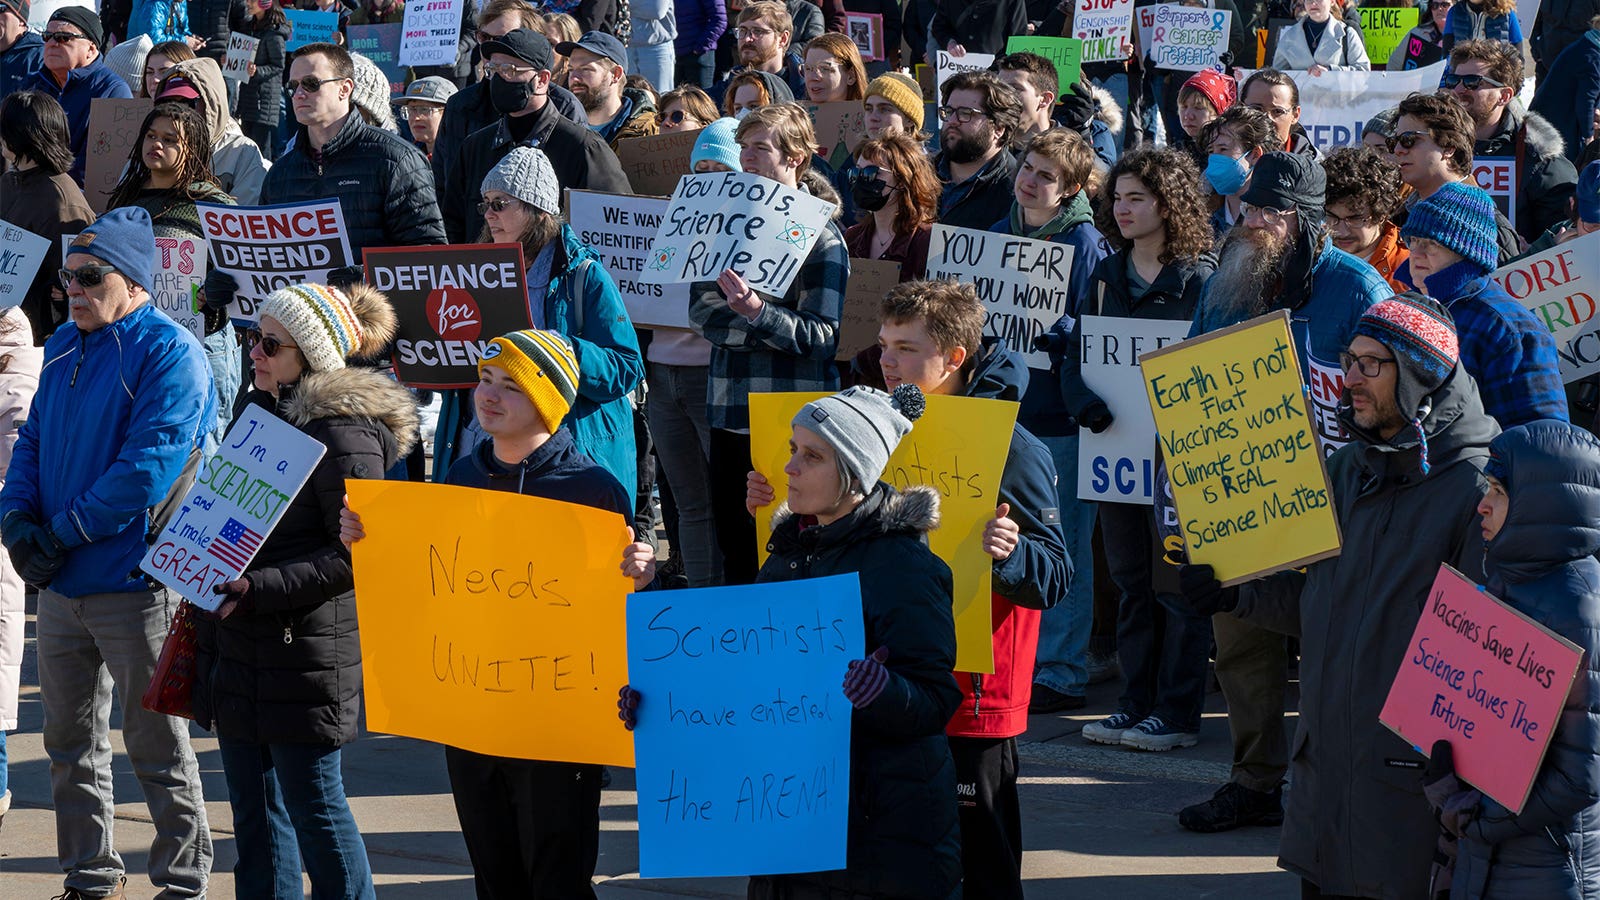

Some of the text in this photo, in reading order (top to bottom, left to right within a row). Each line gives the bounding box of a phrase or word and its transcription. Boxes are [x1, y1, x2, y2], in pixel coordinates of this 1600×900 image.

[408, 12, 456, 27] DISASTER
[426, 1, 452, 11] EVERY
[352, 38, 378, 49] MORE
[1091, 28, 1103, 38] IN
[204, 208, 339, 240] SCIENCE
[633, 212, 664, 229] WAN
[665, 206, 765, 241] Science
[220, 243, 331, 270] DEFEND
[942, 230, 1065, 282] YOU FEAR
[374, 262, 517, 291] DEFIANCE
[619, 279, 663, 298] FACTS
[151, 290, 189, 311] YOUR
[437, 290, 474, 335] for
[1013, 283, 1065, 314] WON'T
[396, 339, 488, 366] SCIEN
[1150, 337, 1289, 409] Earth is not
[1200, 386, 1247, 419] Flat
[1162, 393, 1304, 457] Vaccines work
[276, 459, 289, 475] a
[1172, 451, 1235, 488] Climate
[1239, 429, 1313, 463] change
[198, 454, 290, 525] SCIENTIST
[1221, 465, 1277, 499] REAL
[192, 495, 216, 511] and
[1186, 509, 1259, 550] Science
[1263, 484, 1329, 525] Matters
[168, 506, 211, 550] I make
[429, 535, 571, 607] Nerds
[643, 606, 847, 662] Scientists
[1432, 590, 1556, 689] Vaccines Save Lives
[432, 634, 599, 693] UNITE!
[668, 687, 833, 727] have entered
[1413, 637, 1539, 742] Science Saves The
[1430, 693, 1476, 740] Future
[657, 769, 713, 824] the
